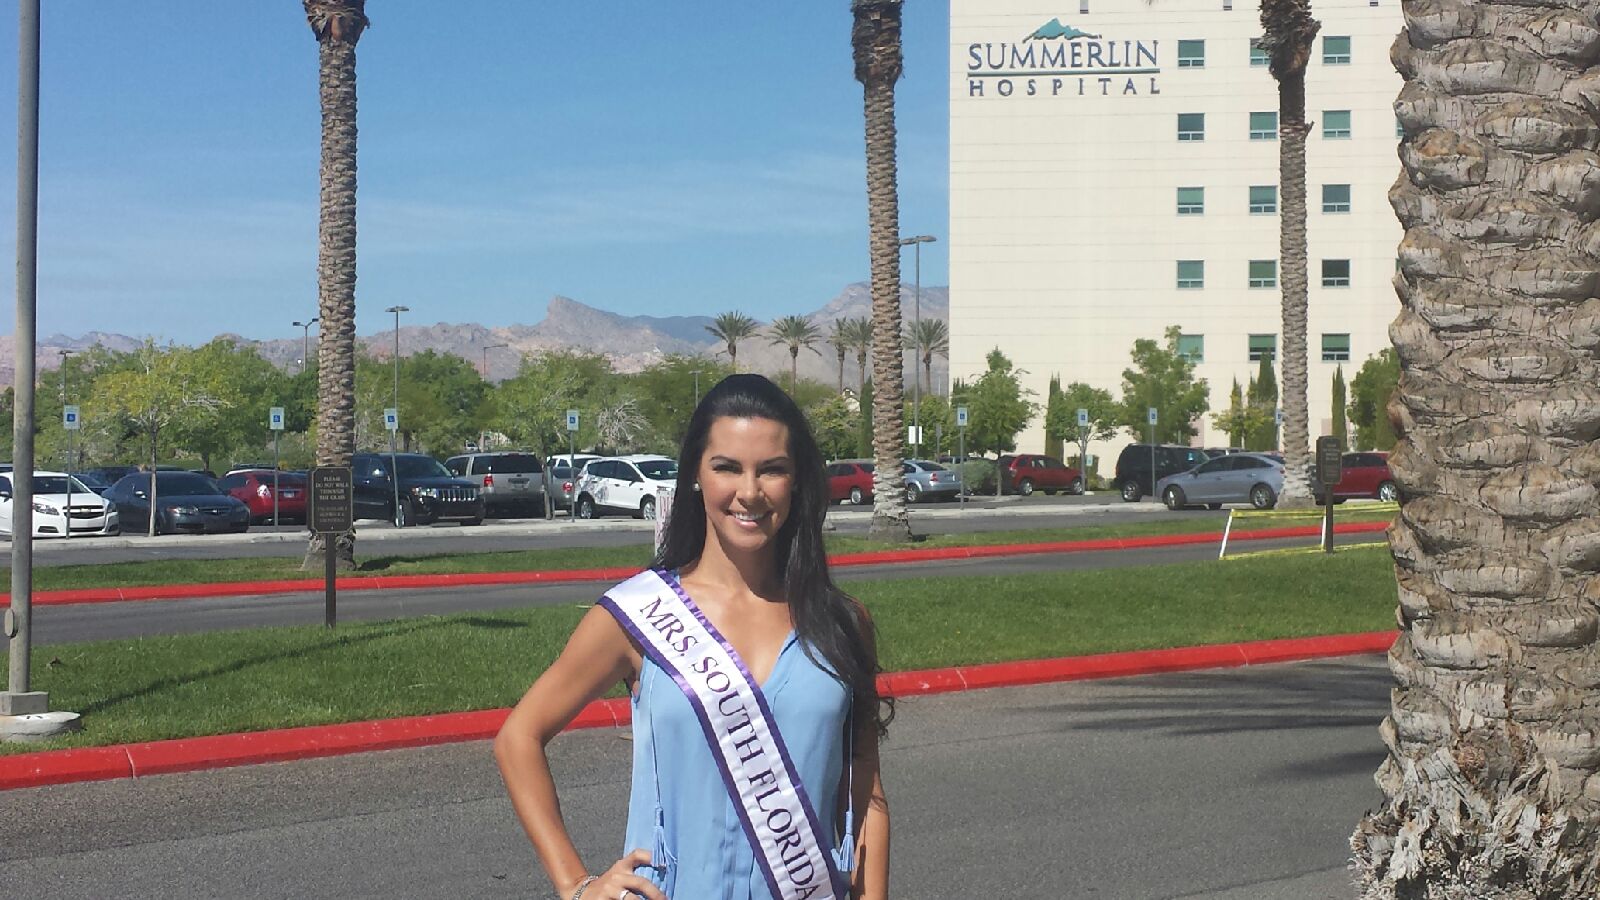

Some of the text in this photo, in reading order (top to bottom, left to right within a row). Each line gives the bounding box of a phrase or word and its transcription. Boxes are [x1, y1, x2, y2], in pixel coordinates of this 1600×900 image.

[968, 40, 1159, 71] SUMMERLIN
[969, 77, 1160, 97] HOSPITAL
[639, 595, 821, 900] MRS. SOUTH FLORIDA
